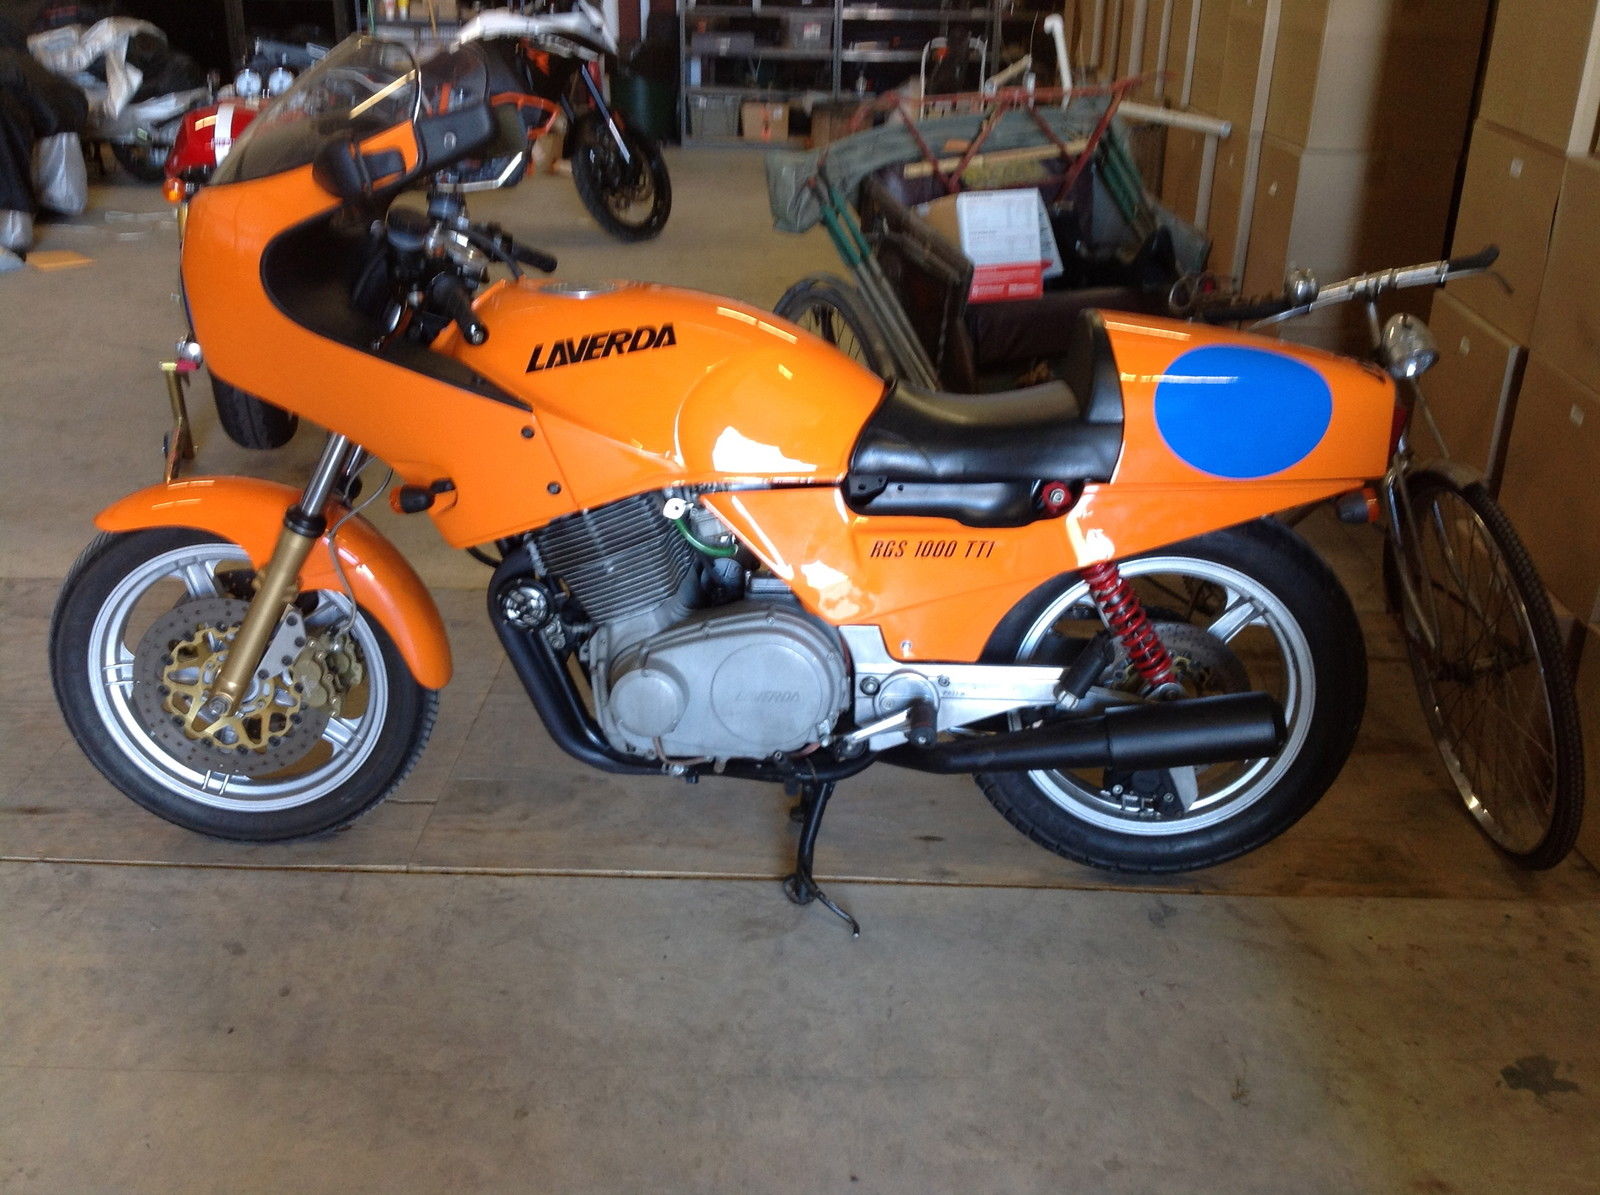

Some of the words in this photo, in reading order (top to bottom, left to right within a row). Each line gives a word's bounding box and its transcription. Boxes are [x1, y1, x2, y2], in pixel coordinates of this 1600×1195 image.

[525, 322, 677, 374] LAVERDA
[870, 540, 908, 558] RGS
[914, 540, 958, 558] 1000
